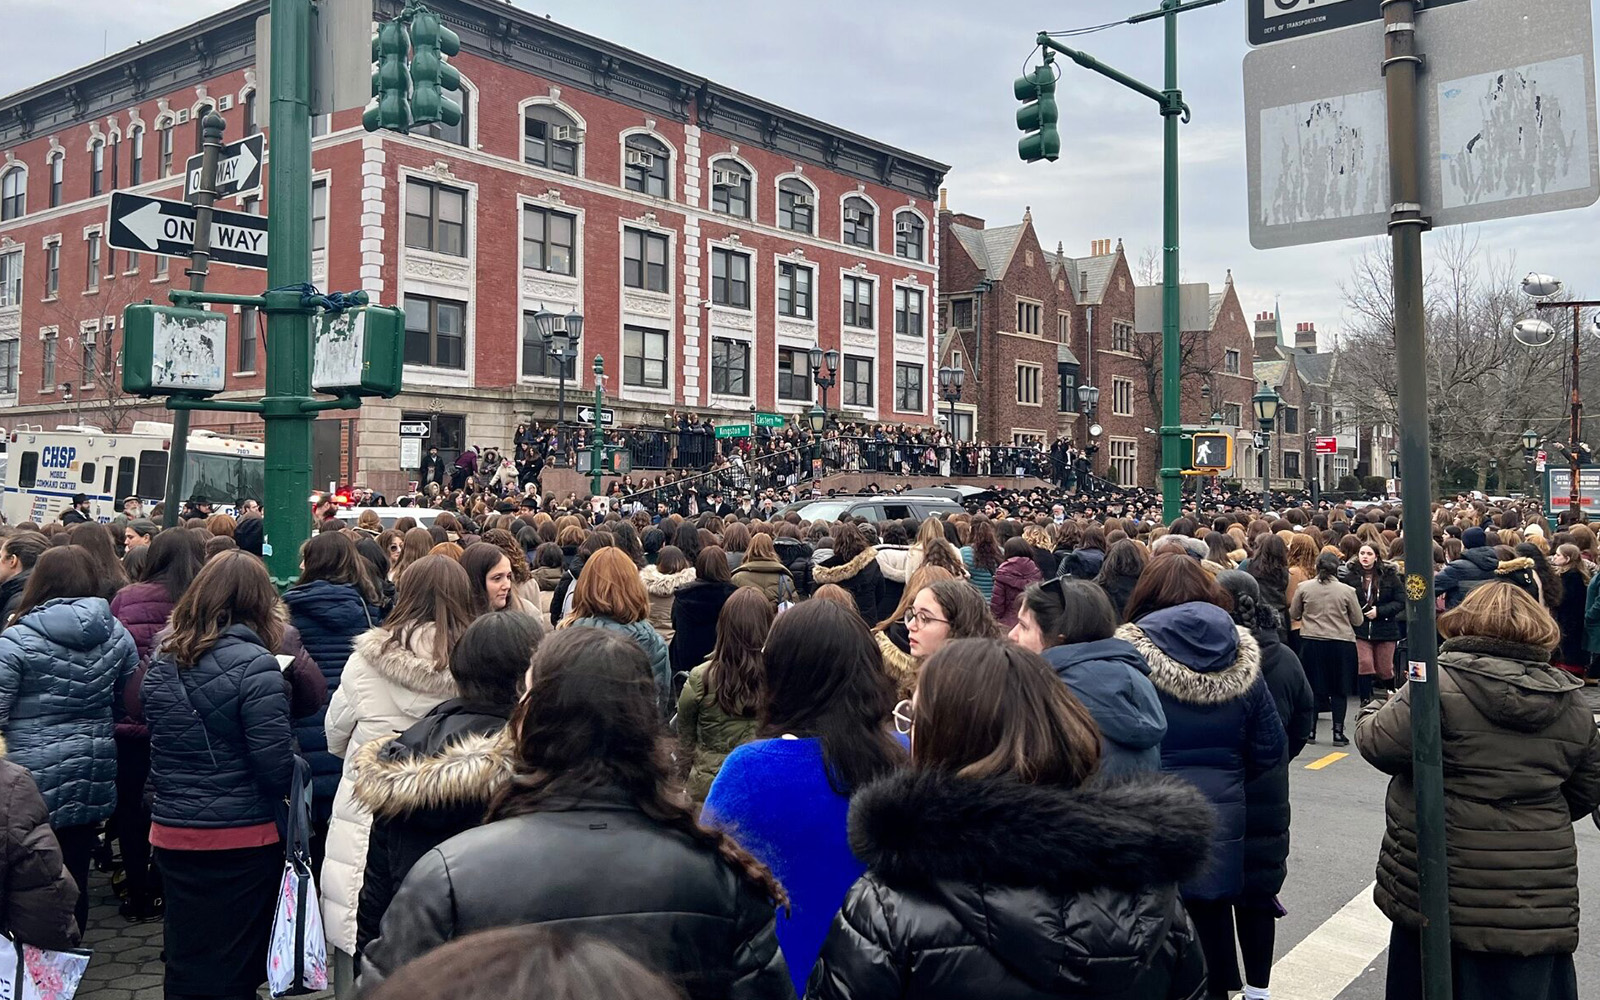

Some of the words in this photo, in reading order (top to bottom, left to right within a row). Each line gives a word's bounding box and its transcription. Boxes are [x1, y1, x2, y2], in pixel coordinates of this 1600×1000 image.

[1286, 16, 1327, 28] TRANSPORTATION
[217, 158, 239, 183] WAY
[164, 218, 195, 242] ON
[218, 226, 263, 251] WAY
[757, 415, 773, 425] Eastern
[720, 427, 740, 437] Kingston
[42, 446, 76, 468] CHSP
[50, 471, 66, 479] MOBILE
[36, 480, 58, 488] COMMAND
[59, 482, 76, 490] CENTER
